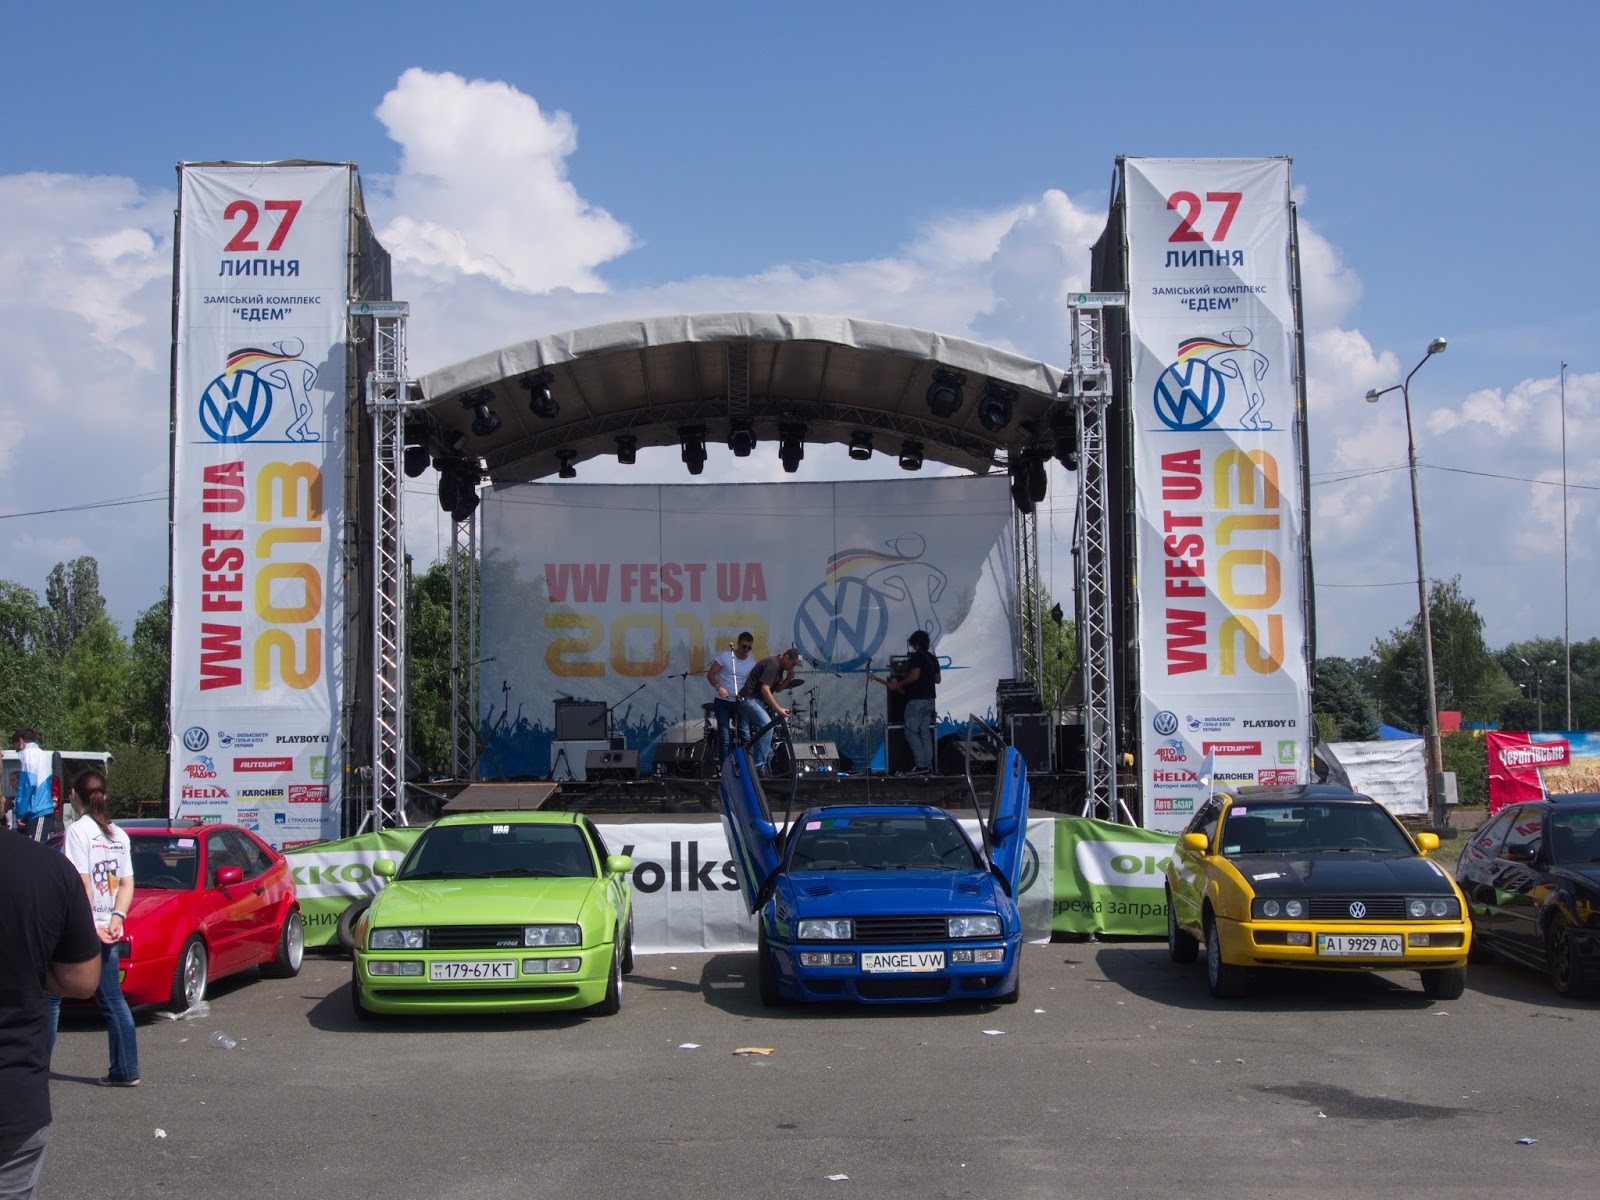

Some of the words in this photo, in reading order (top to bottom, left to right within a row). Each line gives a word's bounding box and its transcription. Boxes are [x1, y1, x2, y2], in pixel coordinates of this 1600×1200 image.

[223, 199, 303, 252] 27
[1166, 190, 1243, 242] 27
[218, 259, 300, 277] ЛИПНЯ
[1164, 249, 1244, 268] ЛИПНЯ
[203, 295, 264, 305] ЗАМІСЬКИЙ
[266, 295, 321, 305] КОМПЛЕКС
[1152, 285, 1211, 296] ЗАМІСЬКИЙ
[1212, 285, 1267, 296] КОМПЛЕКС
[1161, 448, 1203, 500] UA
[202, 460, 245, 513] UA
[1163, 510, 1206, 598] FEST
[1213, 448, 1285, 676] 2013
[201, 523, 245, 612] FEST
[253, 461, 324, 691] 2013
[544, 563, 610, 603] VW
[620, 562, 707, 603] FEST
[716, 562, 768, 602] UA
[1165, 608, 1208, 676] VW
[200, 622, 242, 691] VW
[1242, 719, 1286, 728] PLAYBOY
[275, 735, 320, 744] PLAYBOY
[1154, 748, 1176, 756] АВТО
[1160, 755, 1187, 763] РАДИО
[183, 764, 206, 772] АВТО
[189, 771, 217, 779] РАДИО
[1153, 772, 1198, 782] HELIX
[182, 788, 227, 799] HELIX
[291, 863, 372, 885] KKO
[621, 840, 741, 894] olks
[1111, 855, 1173, 875] OK
[1053, 900, 1102, 916] ережа
[1348, 938, 1377, 951] 9929
[1380, 938, 1398, 951] AO
[873, 954, 917, 968] ANGEL
[919, 953, 943, 967] VW
